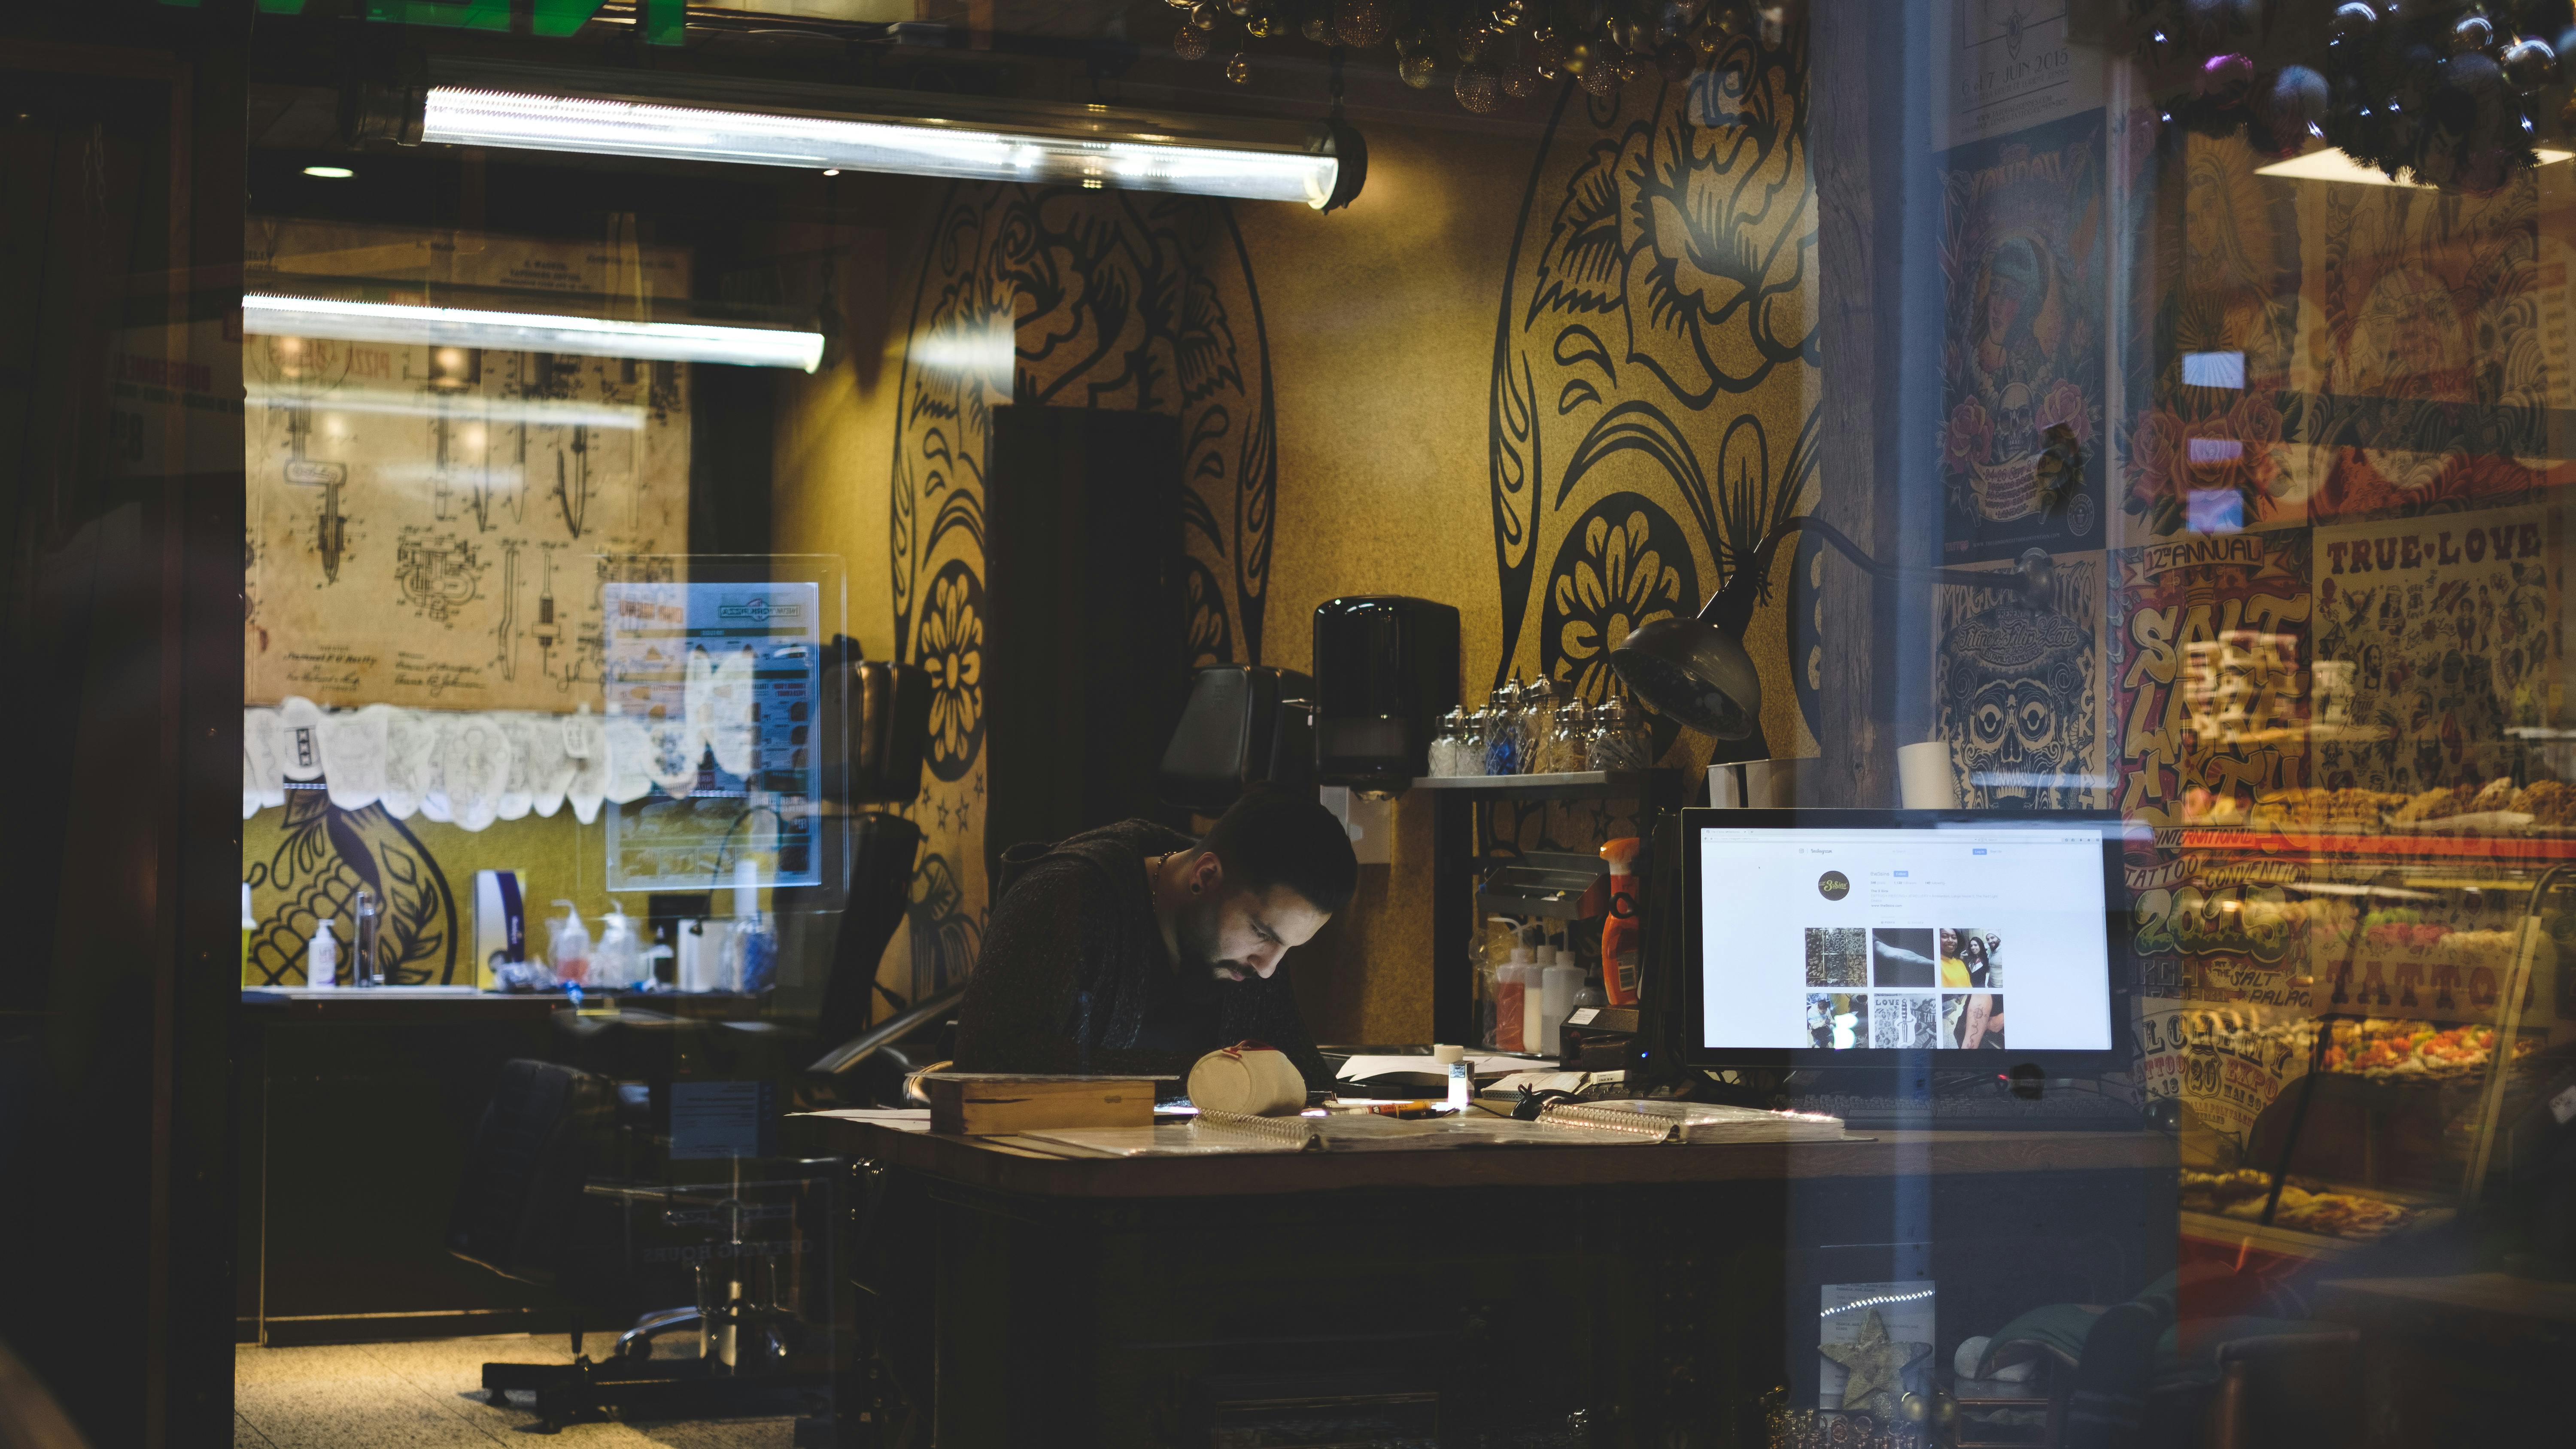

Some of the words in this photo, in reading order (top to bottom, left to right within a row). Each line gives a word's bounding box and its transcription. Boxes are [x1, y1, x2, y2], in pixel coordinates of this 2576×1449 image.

[1961, 79, 1970, 96] 6
[1987, 71, 1996, 89] 7
[2003, 61, 2030, 83] JUIN
[2035, 47, 2069, 73] 2015
[2172, 537, 2260, 567] ANNUAL
[2327, 533, 2423, 575] TRUE
[2438, 522, 2542, 566] LOVE
[2123, 592, 2312, 688] SALT
[2156, 828, 2254, 848] INTERNATIONAL
[2124, 854, 2199, 887] TATTOO
[2205, 860, 2312, 887] CONVENTION
[1824, 880, 1832, 892] 3
[2135, 885, 2290, 963] 2015
[2212, 968, 2231, 977] THE
[2230, 970, 2281, 987] SALT
[2248, 989, 2312, 1007] PALAC
[2127, 1054, 2186, 1085] ATTOO
[2224, 1057, 2278, 1101] EXPO
[2224, 1083, 2244, 1104] MAI
